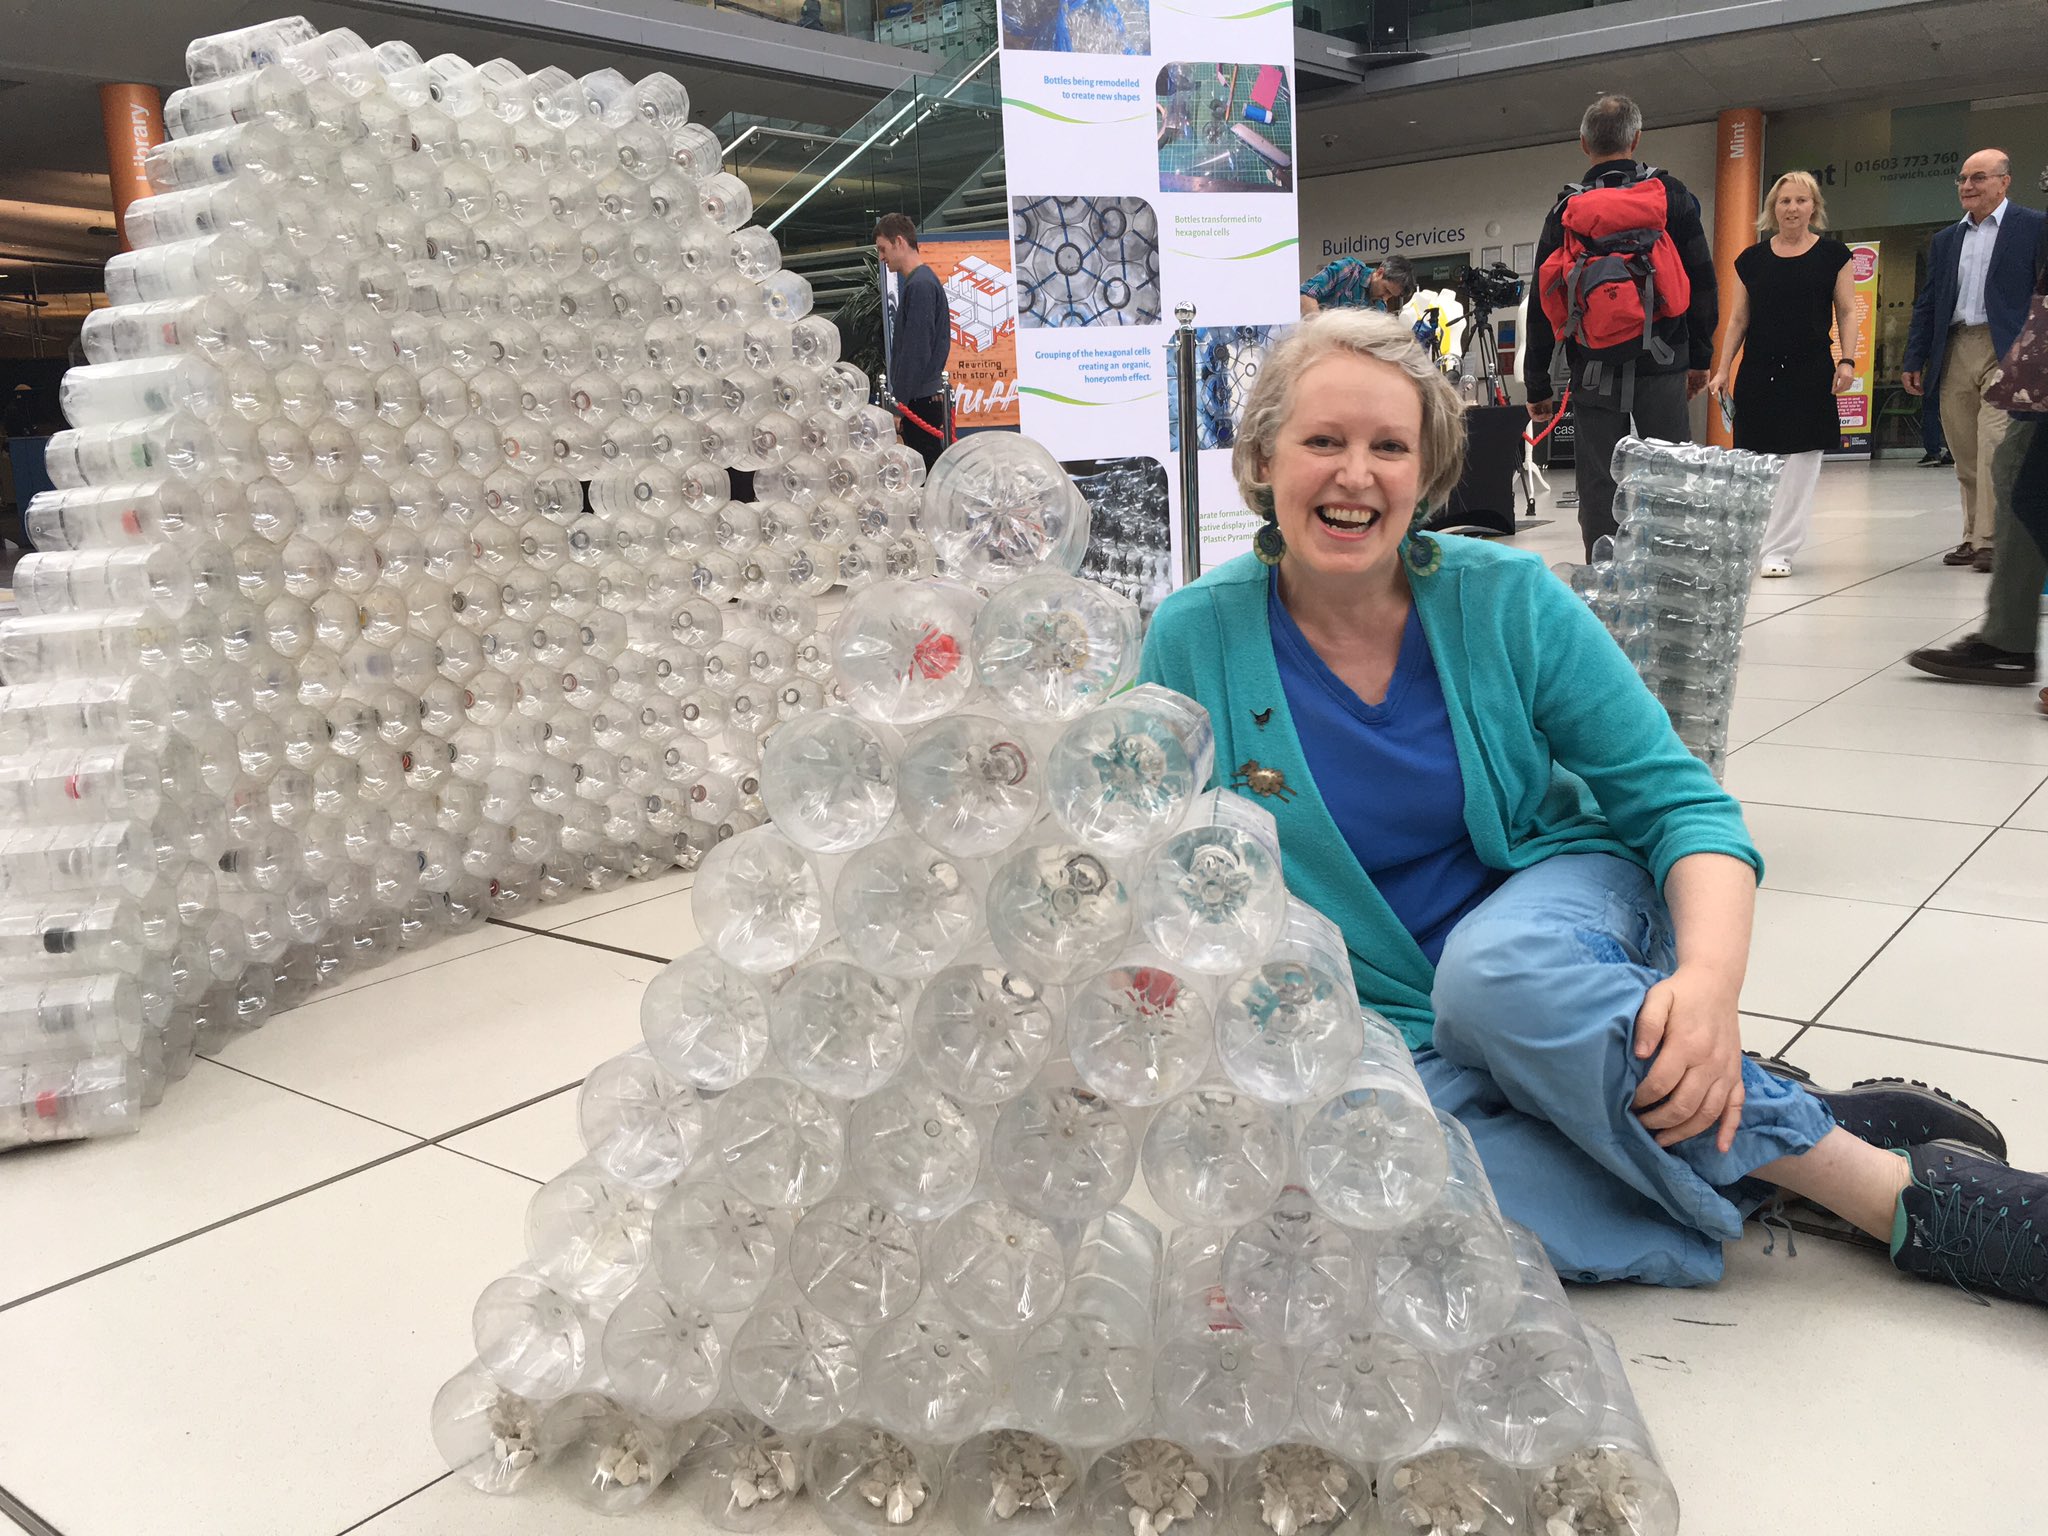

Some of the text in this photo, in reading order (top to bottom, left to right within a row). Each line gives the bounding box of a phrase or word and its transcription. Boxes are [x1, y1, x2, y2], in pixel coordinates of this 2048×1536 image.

[1043, 75, 1140, 88] Bottles being remodelled
[1062, 91, 1071, 99] to
[1071, 92, 1095, 100] create
[1113, 92, 1141, 102] shapes
[129, 102, 151, 181] Library
[1730, 121, 1746, 159] Mint
[1854, 157, 1898, 173] 01603
[1903, 154, 1929, 167] 773
[1933, 151, 1960, 165] 760
[1174, 214, 1263, 224] Bottles transformed into
[1175, 227, 1230, 239] hexagonal cells
[1322, 226, 1466, 257] Building Services
[1034, 346, 1151, 361] Grouping of the hexagonal cells
[958, 359, 1002, 371] Rewriting
[1078, 361, 1109, 371] creating
[1121, 360, 1152, 370] organic,
[952, 369, 1009, 381] the story of
[1084, 372, 1152, 385] honeycomb effect.
[955, 379, 1019, 416] tuff
[1199, 511, 1218, 520] arate
[1199, 522, 1220, 532] eative
[1221, 521, 1247, 531] display
[1247, 520, 1255, 528] in
